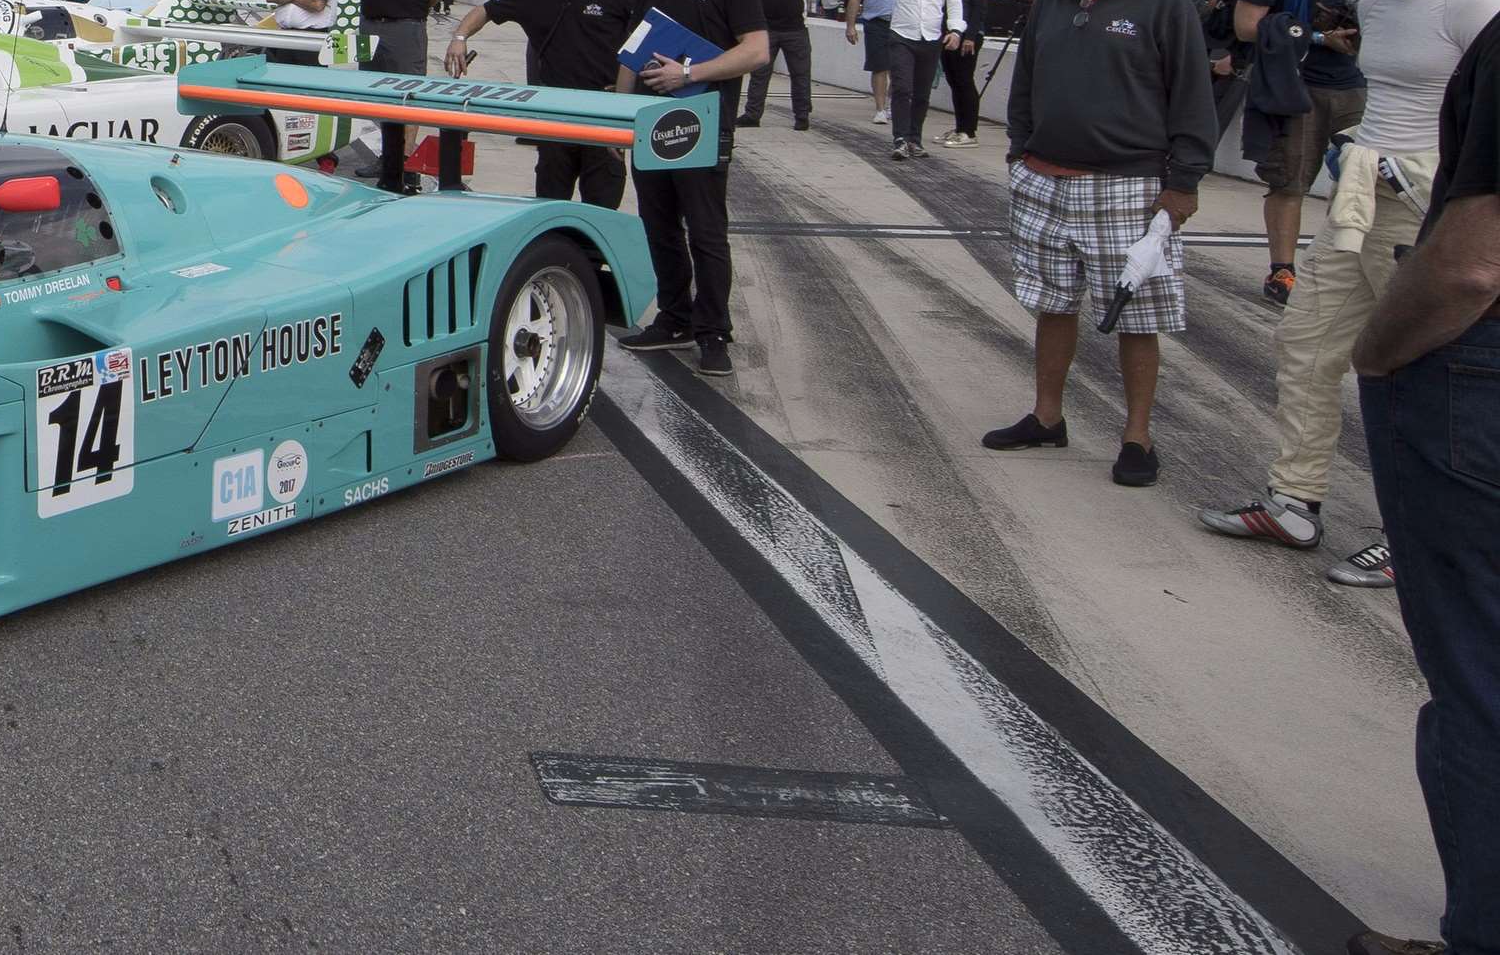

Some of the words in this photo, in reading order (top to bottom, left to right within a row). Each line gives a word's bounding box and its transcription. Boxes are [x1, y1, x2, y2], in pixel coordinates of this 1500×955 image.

[369, 76, 539, 103] POTENZA
[4, 285, 42, 304] TOMMY
[45, 274, 90, 295] DREELAN
[108, 357, 130, 370] 24
[140, 333, 252, 403] LEYTON
[262, 312, 342, 371] HOUSE
[48, 379, 124, 498] 14
[220, 465, 258, 505] C1A
[279, 478, 297, 495] 2017
[344, 477, 390, 507] SACHS
[229, 504, 297, 536] ZENITH
